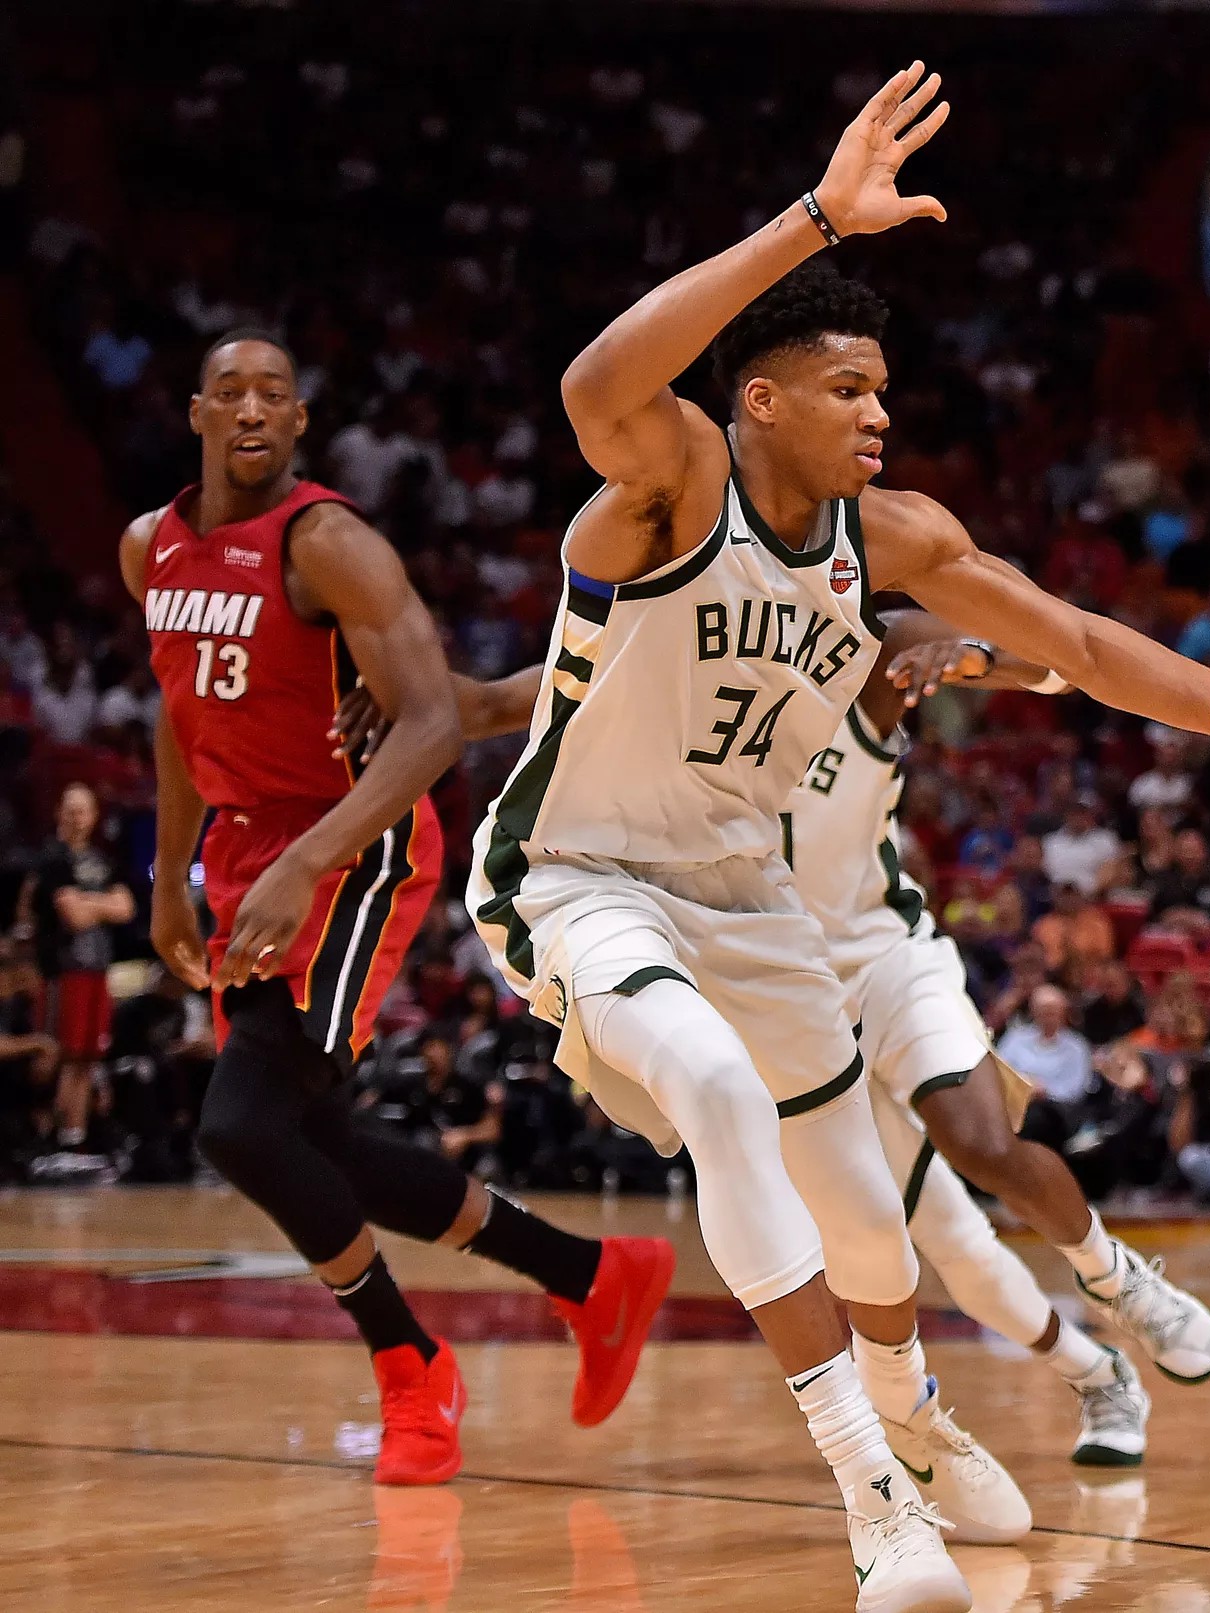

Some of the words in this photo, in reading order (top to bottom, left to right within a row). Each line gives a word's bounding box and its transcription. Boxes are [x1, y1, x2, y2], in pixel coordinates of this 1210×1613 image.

[144, 586, 265, 638] MIAMI
[695, 598, 863, 688] BUCKS
[194, 637, 250, 701] 13
[684, 685, 798, 768] 34
